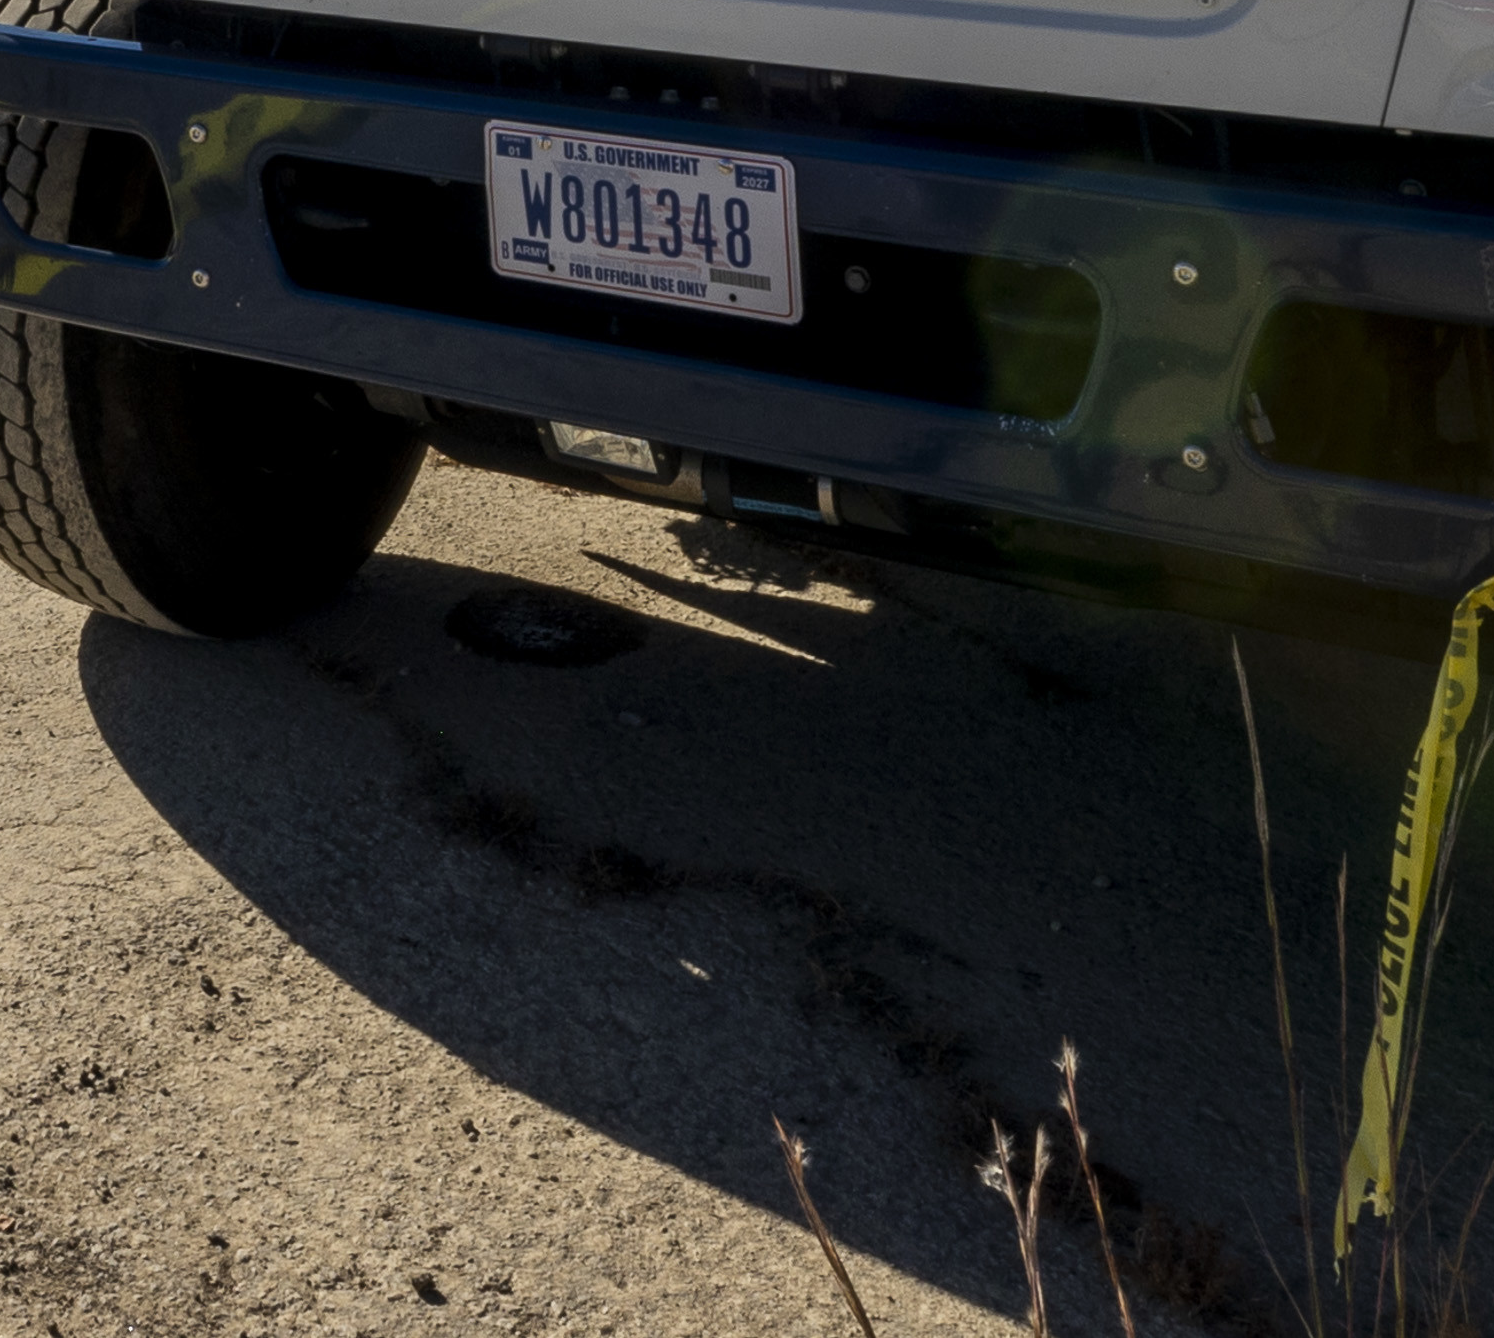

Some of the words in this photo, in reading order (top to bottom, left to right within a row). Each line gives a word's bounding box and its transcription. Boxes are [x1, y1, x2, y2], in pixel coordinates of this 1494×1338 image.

[508, 145, 520, 156] 01
[563, 141, 593, 163] U.S.
[595, 147, 701, 176] GOVERNMENT
[742, 176, 769, 190] 2027
[521, 168, 752, 269] W801348
[501, 240, 509, 260] B
[515, 244, 547, 260] ARMY
[570, 262, 593, 280] FOR
[595, 266, 649, 289] OFFICIAL
[650, 276, 676, 294] USE
[677, 280, 708, 298] ONLY
